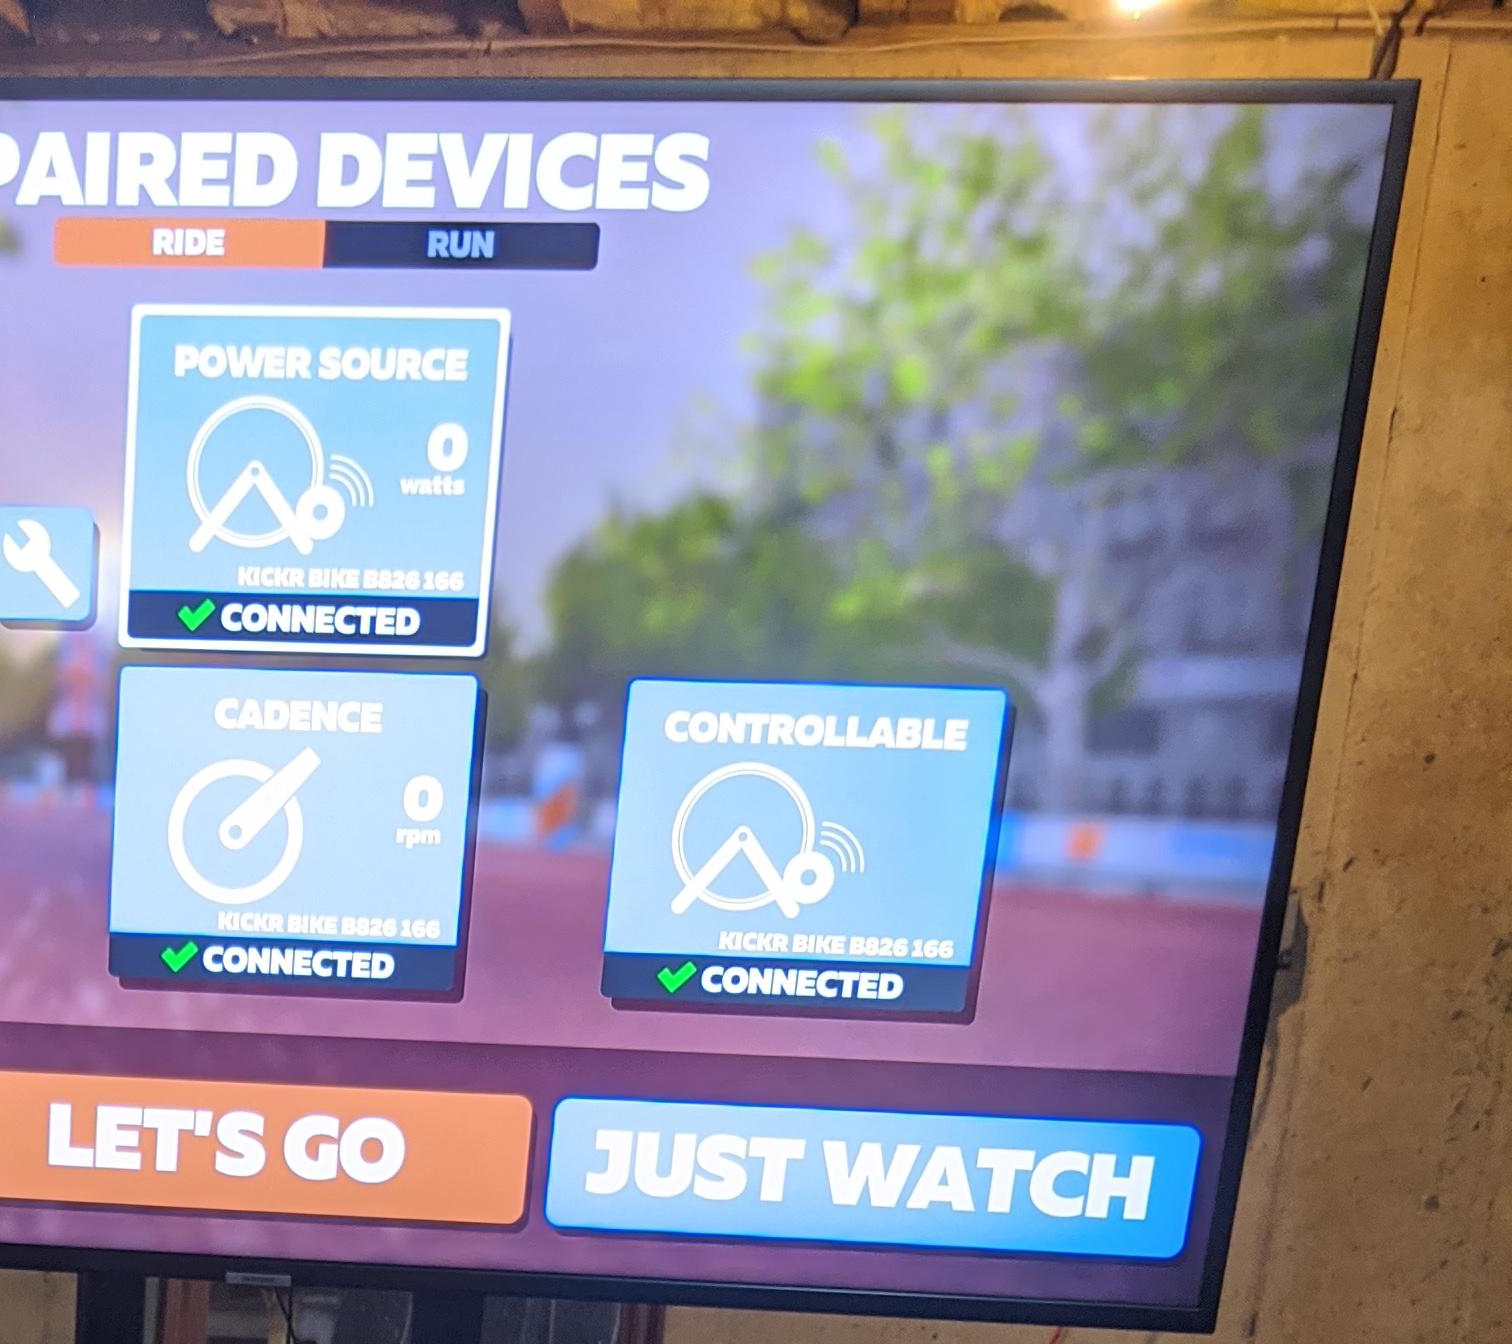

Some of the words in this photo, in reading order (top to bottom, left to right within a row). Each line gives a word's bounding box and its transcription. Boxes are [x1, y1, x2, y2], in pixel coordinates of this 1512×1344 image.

[317, 132, 710, 212] DEVICES
[151, 228, 226, 256] RIDE
[426, 229, 495, 259] RUN
[174, 344, 312, 380] POWER
[318, 347, 469, 382] SOURCE
[427, 422, 469, 473] 0
[400, 475, 466, 497] watts
[237, 565, 304, 588] KICKR
[308, 568, 360, 589] BIKE
[363, 569, 420, 590] B826
[423, 571, 465, 592] 166
[220, 603, 421, 636] CONNECTED
[214, 697, 384, 734] CADENCE
[664, 710, 970, 751] CONTROLLABLE
[402, 775, 444, 822] 0
[396, 827, 441, 849] rpm
[217, 911, 284, 932] KICKR
[288, 914, 338, 935] BIKE
[342, 916, 396, 937] B826
[400, 919, 440, 939] 166
[202, 945, 395, 979] CONNECTED
[719, 931, 788, 953] KICKR
[792, 933, 846, 955] BIKE
[849, 935, 908, 957] B826
[911, 937, 954, 959] 166
[701, 966, 904, 1000] CONNECTED
[46, 1102, 266, 1177] LET'S
[283, 1113, 406, 1185] GO
[584, 1129, 805, 1206] JUST
[821, 1142, 1155, 1222] WATCH
